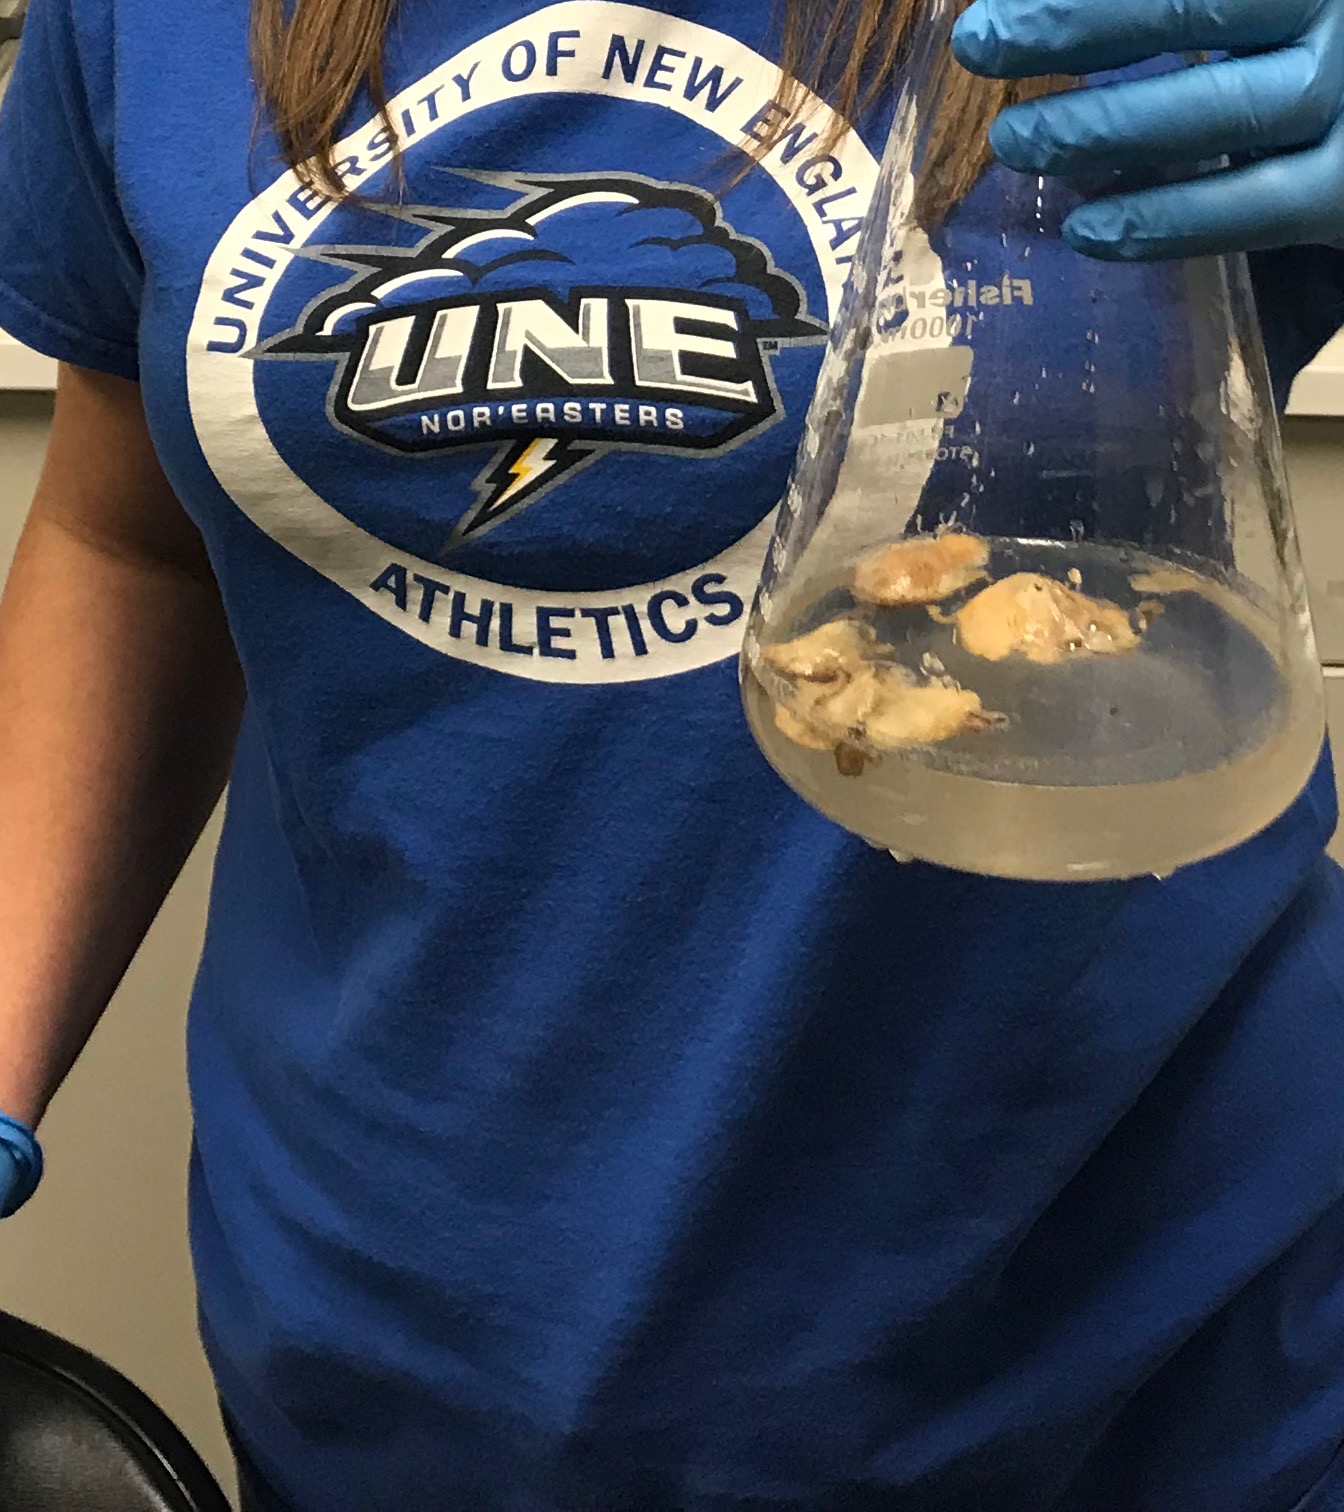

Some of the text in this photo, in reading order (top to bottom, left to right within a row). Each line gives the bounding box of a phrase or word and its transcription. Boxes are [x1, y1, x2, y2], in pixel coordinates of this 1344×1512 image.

[206, 29, 868, 354] UNIVERSITY OF NEW ENGLA
[346, 296, 758, 412] UNE
[421, 401, 686, 435] NOR'EASTERS
[369, 562, 745, 661] ATHLETICS
